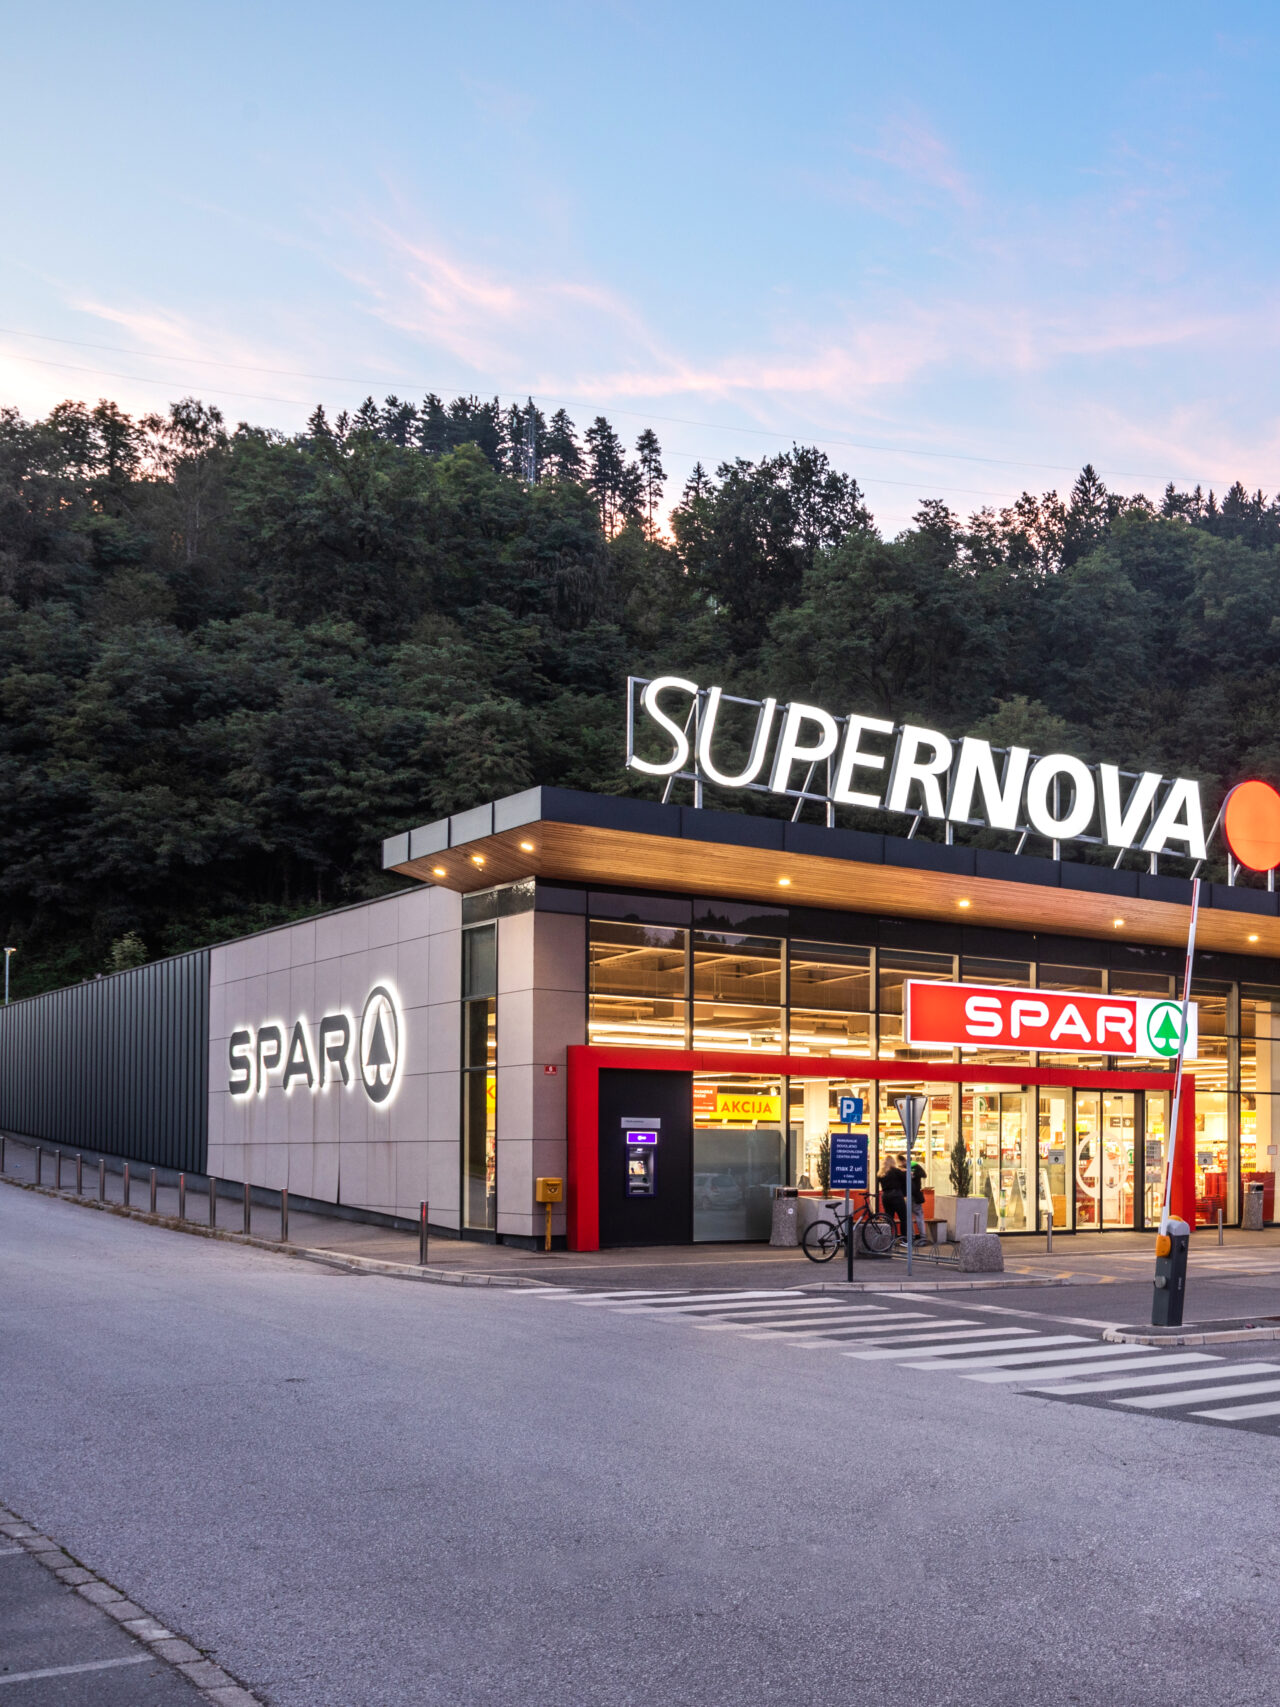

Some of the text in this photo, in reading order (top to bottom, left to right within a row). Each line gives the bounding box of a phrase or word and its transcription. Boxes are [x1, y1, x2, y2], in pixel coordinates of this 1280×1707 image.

[630, 676, 1207, 860] SUPERNOVA
[965, 996, 1134, 1046] SPAR
[229, 1013, 350, 1096] SPAR
[720, 1101, 773, 1114] AKCIJA
[842, 1099, 855, 1119] P
